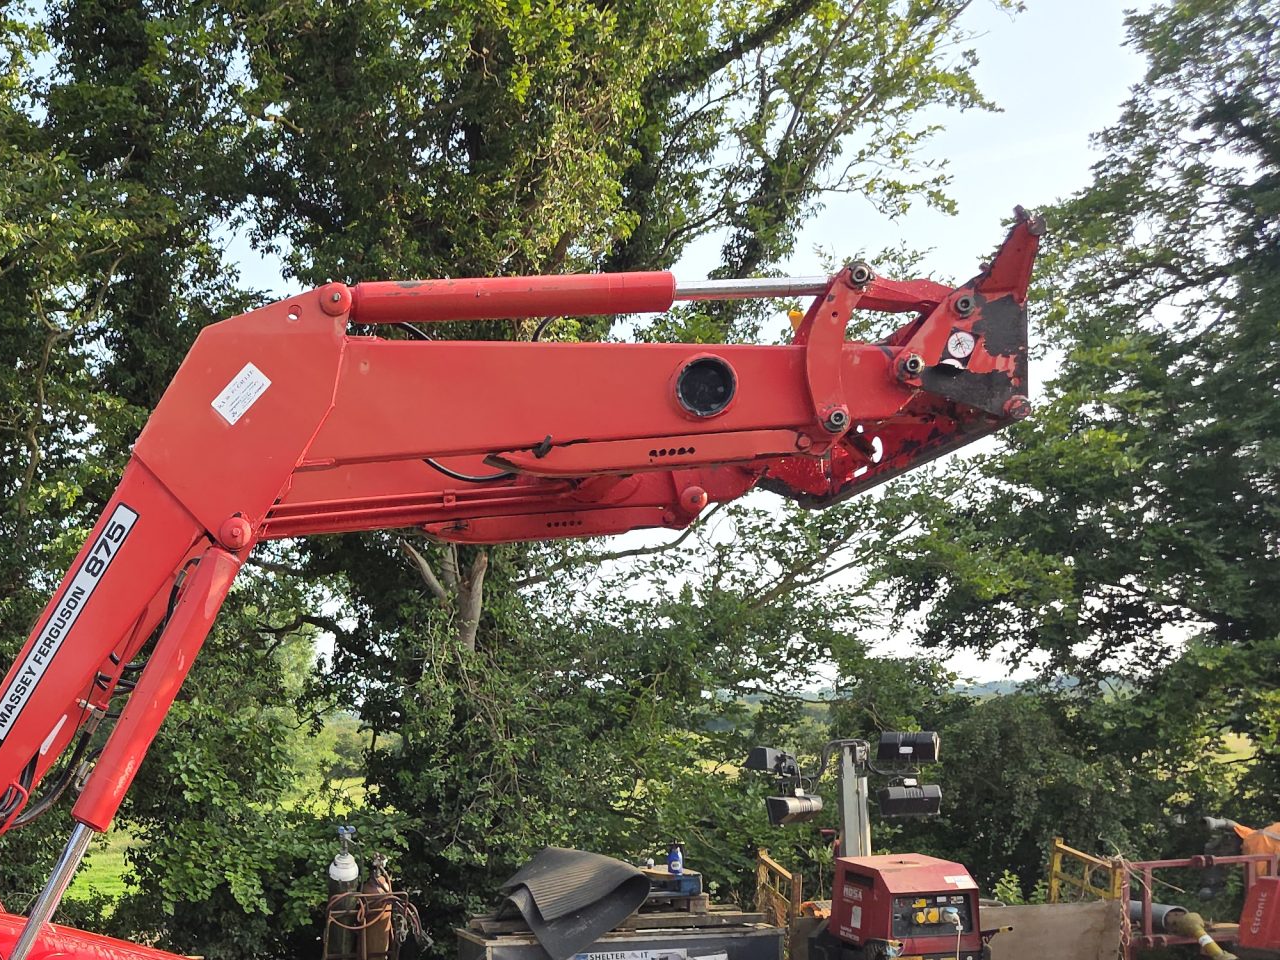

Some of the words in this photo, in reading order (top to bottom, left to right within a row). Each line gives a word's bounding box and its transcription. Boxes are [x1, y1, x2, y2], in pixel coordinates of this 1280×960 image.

[33, 585, 86, 666] FERGUSON
[84, 520, 126, 578] 875
[1250, 891, 1268, 935] Etronic
[589, 952, 626, 960] SHELTER
[640, 951, 649, 959] IT
